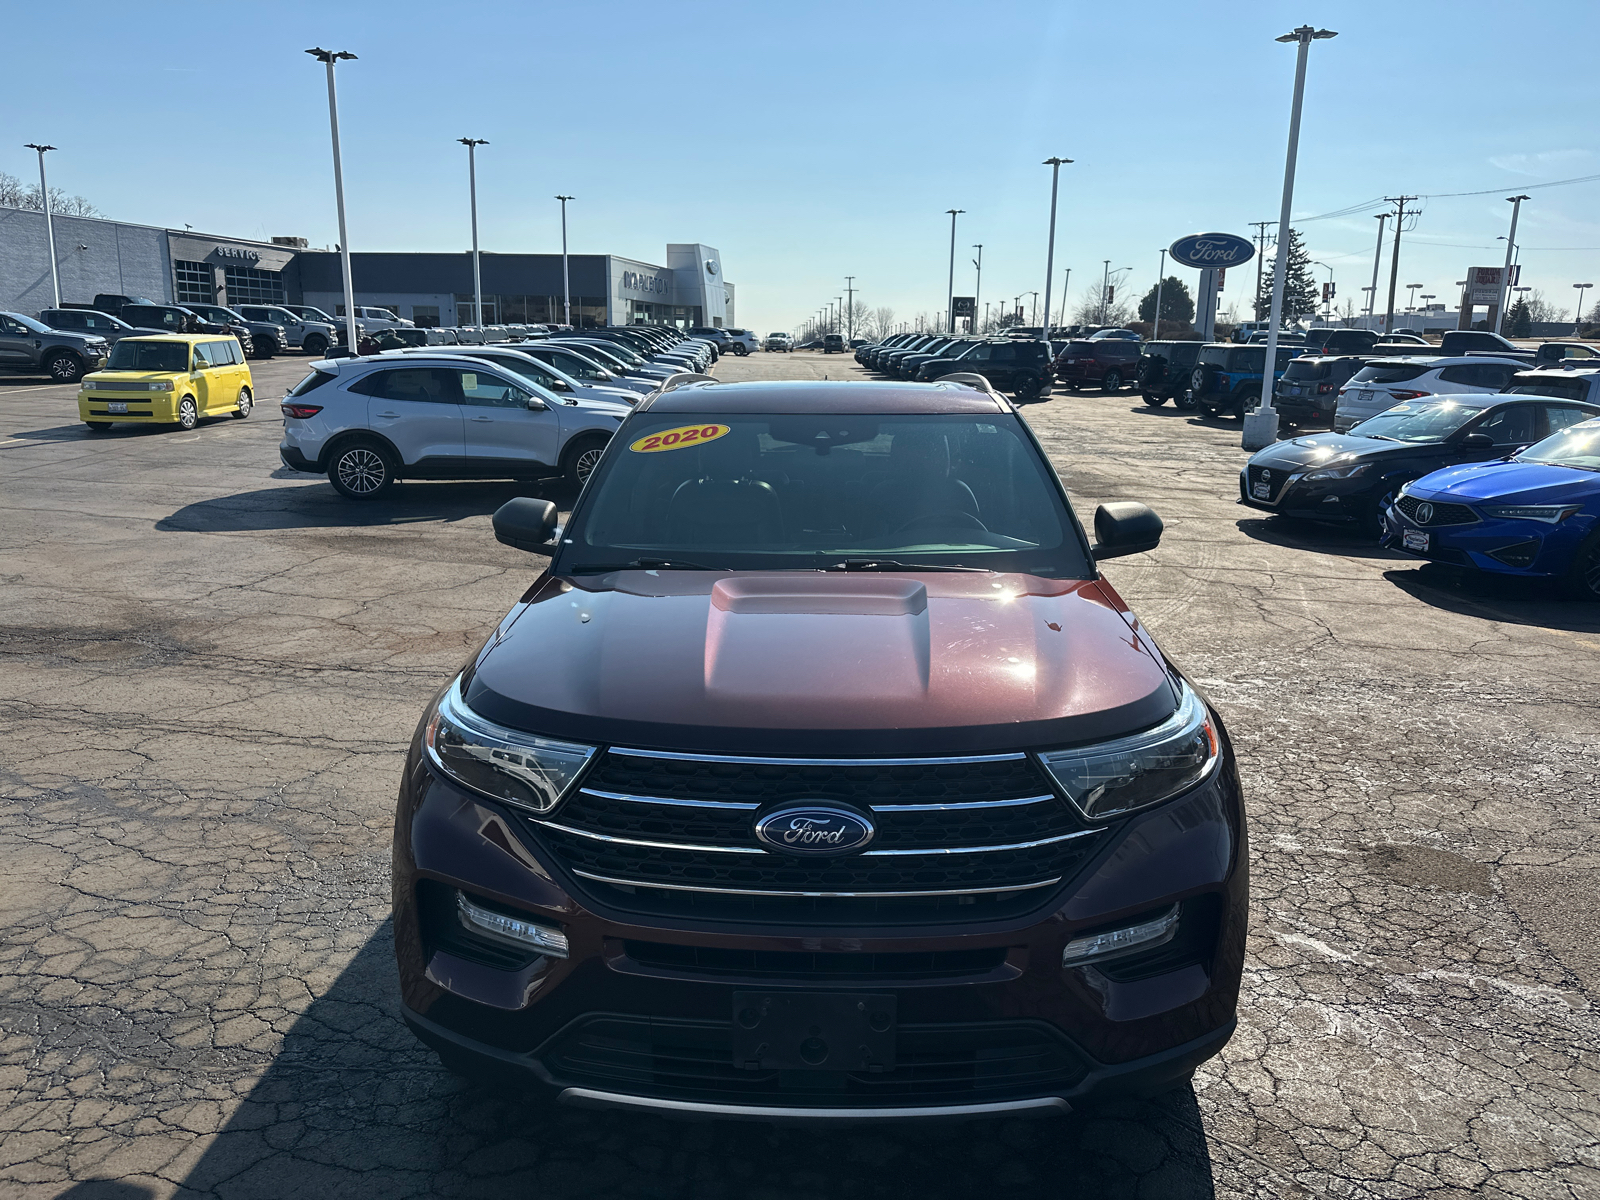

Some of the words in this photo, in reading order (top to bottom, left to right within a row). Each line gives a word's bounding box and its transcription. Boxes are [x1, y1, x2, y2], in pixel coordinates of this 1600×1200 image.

[217, 246, 263, 262] SERVICE
[1189, 239, 1239, 261] Ford
[623, 270, 669, 296] NAPLETON
[641, 425, 720, 451] 2020
[783, 817, 846, 844] Ford
